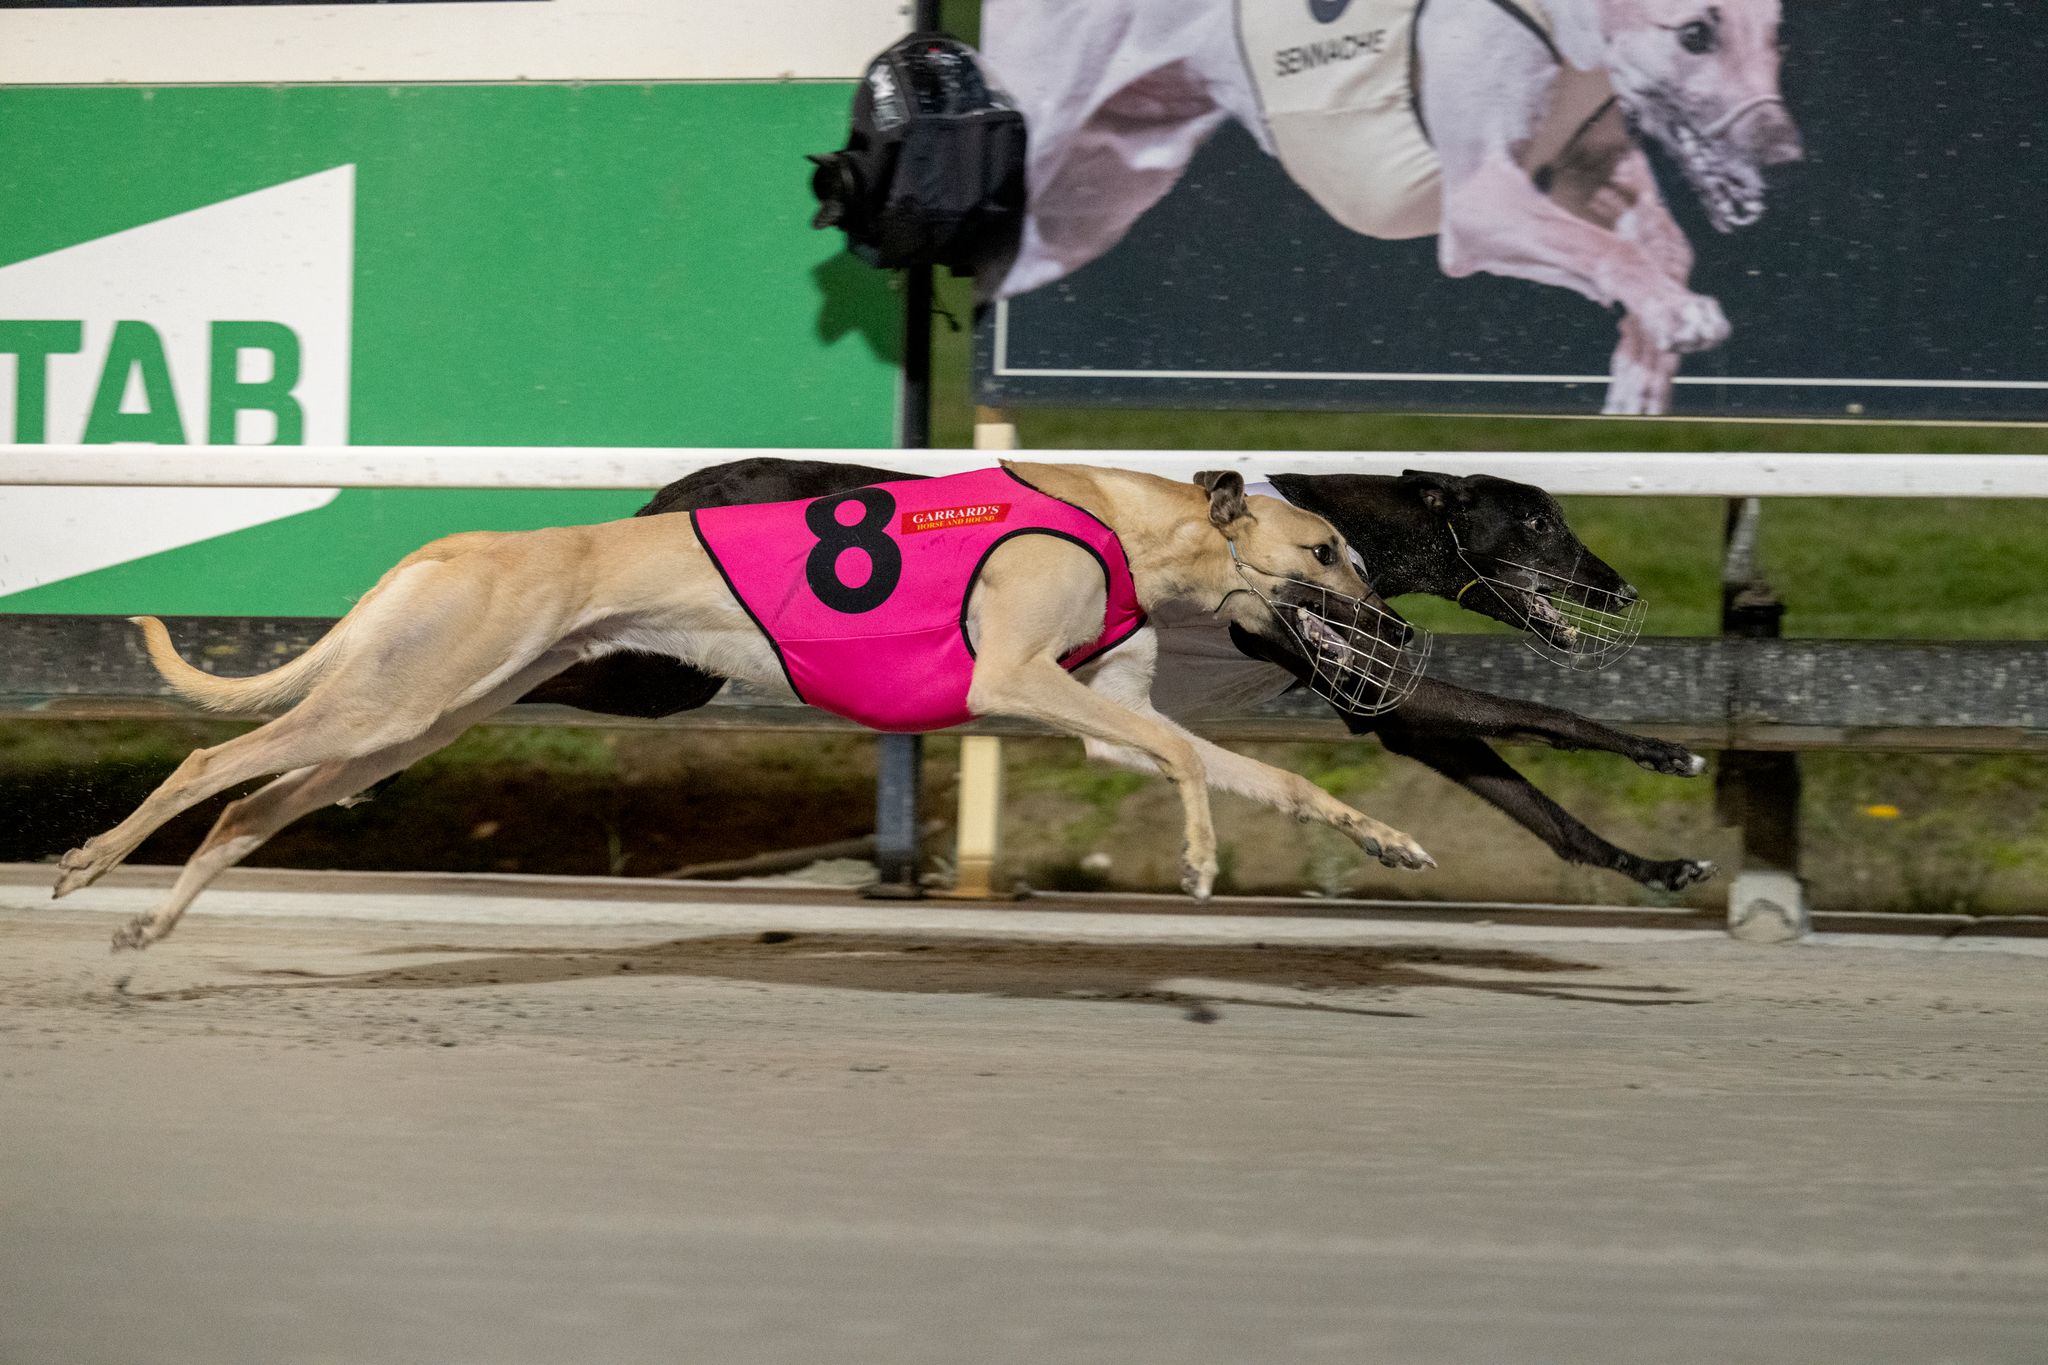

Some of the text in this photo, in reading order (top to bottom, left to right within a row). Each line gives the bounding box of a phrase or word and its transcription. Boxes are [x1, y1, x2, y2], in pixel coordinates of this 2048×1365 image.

[0, 319, 306, 446] TAB
[805, 487, 902, 614] 8
[912, 505, 1000, 524] GARRARD'S
[917, 515, 995, 531] HORSE AND HOUND
